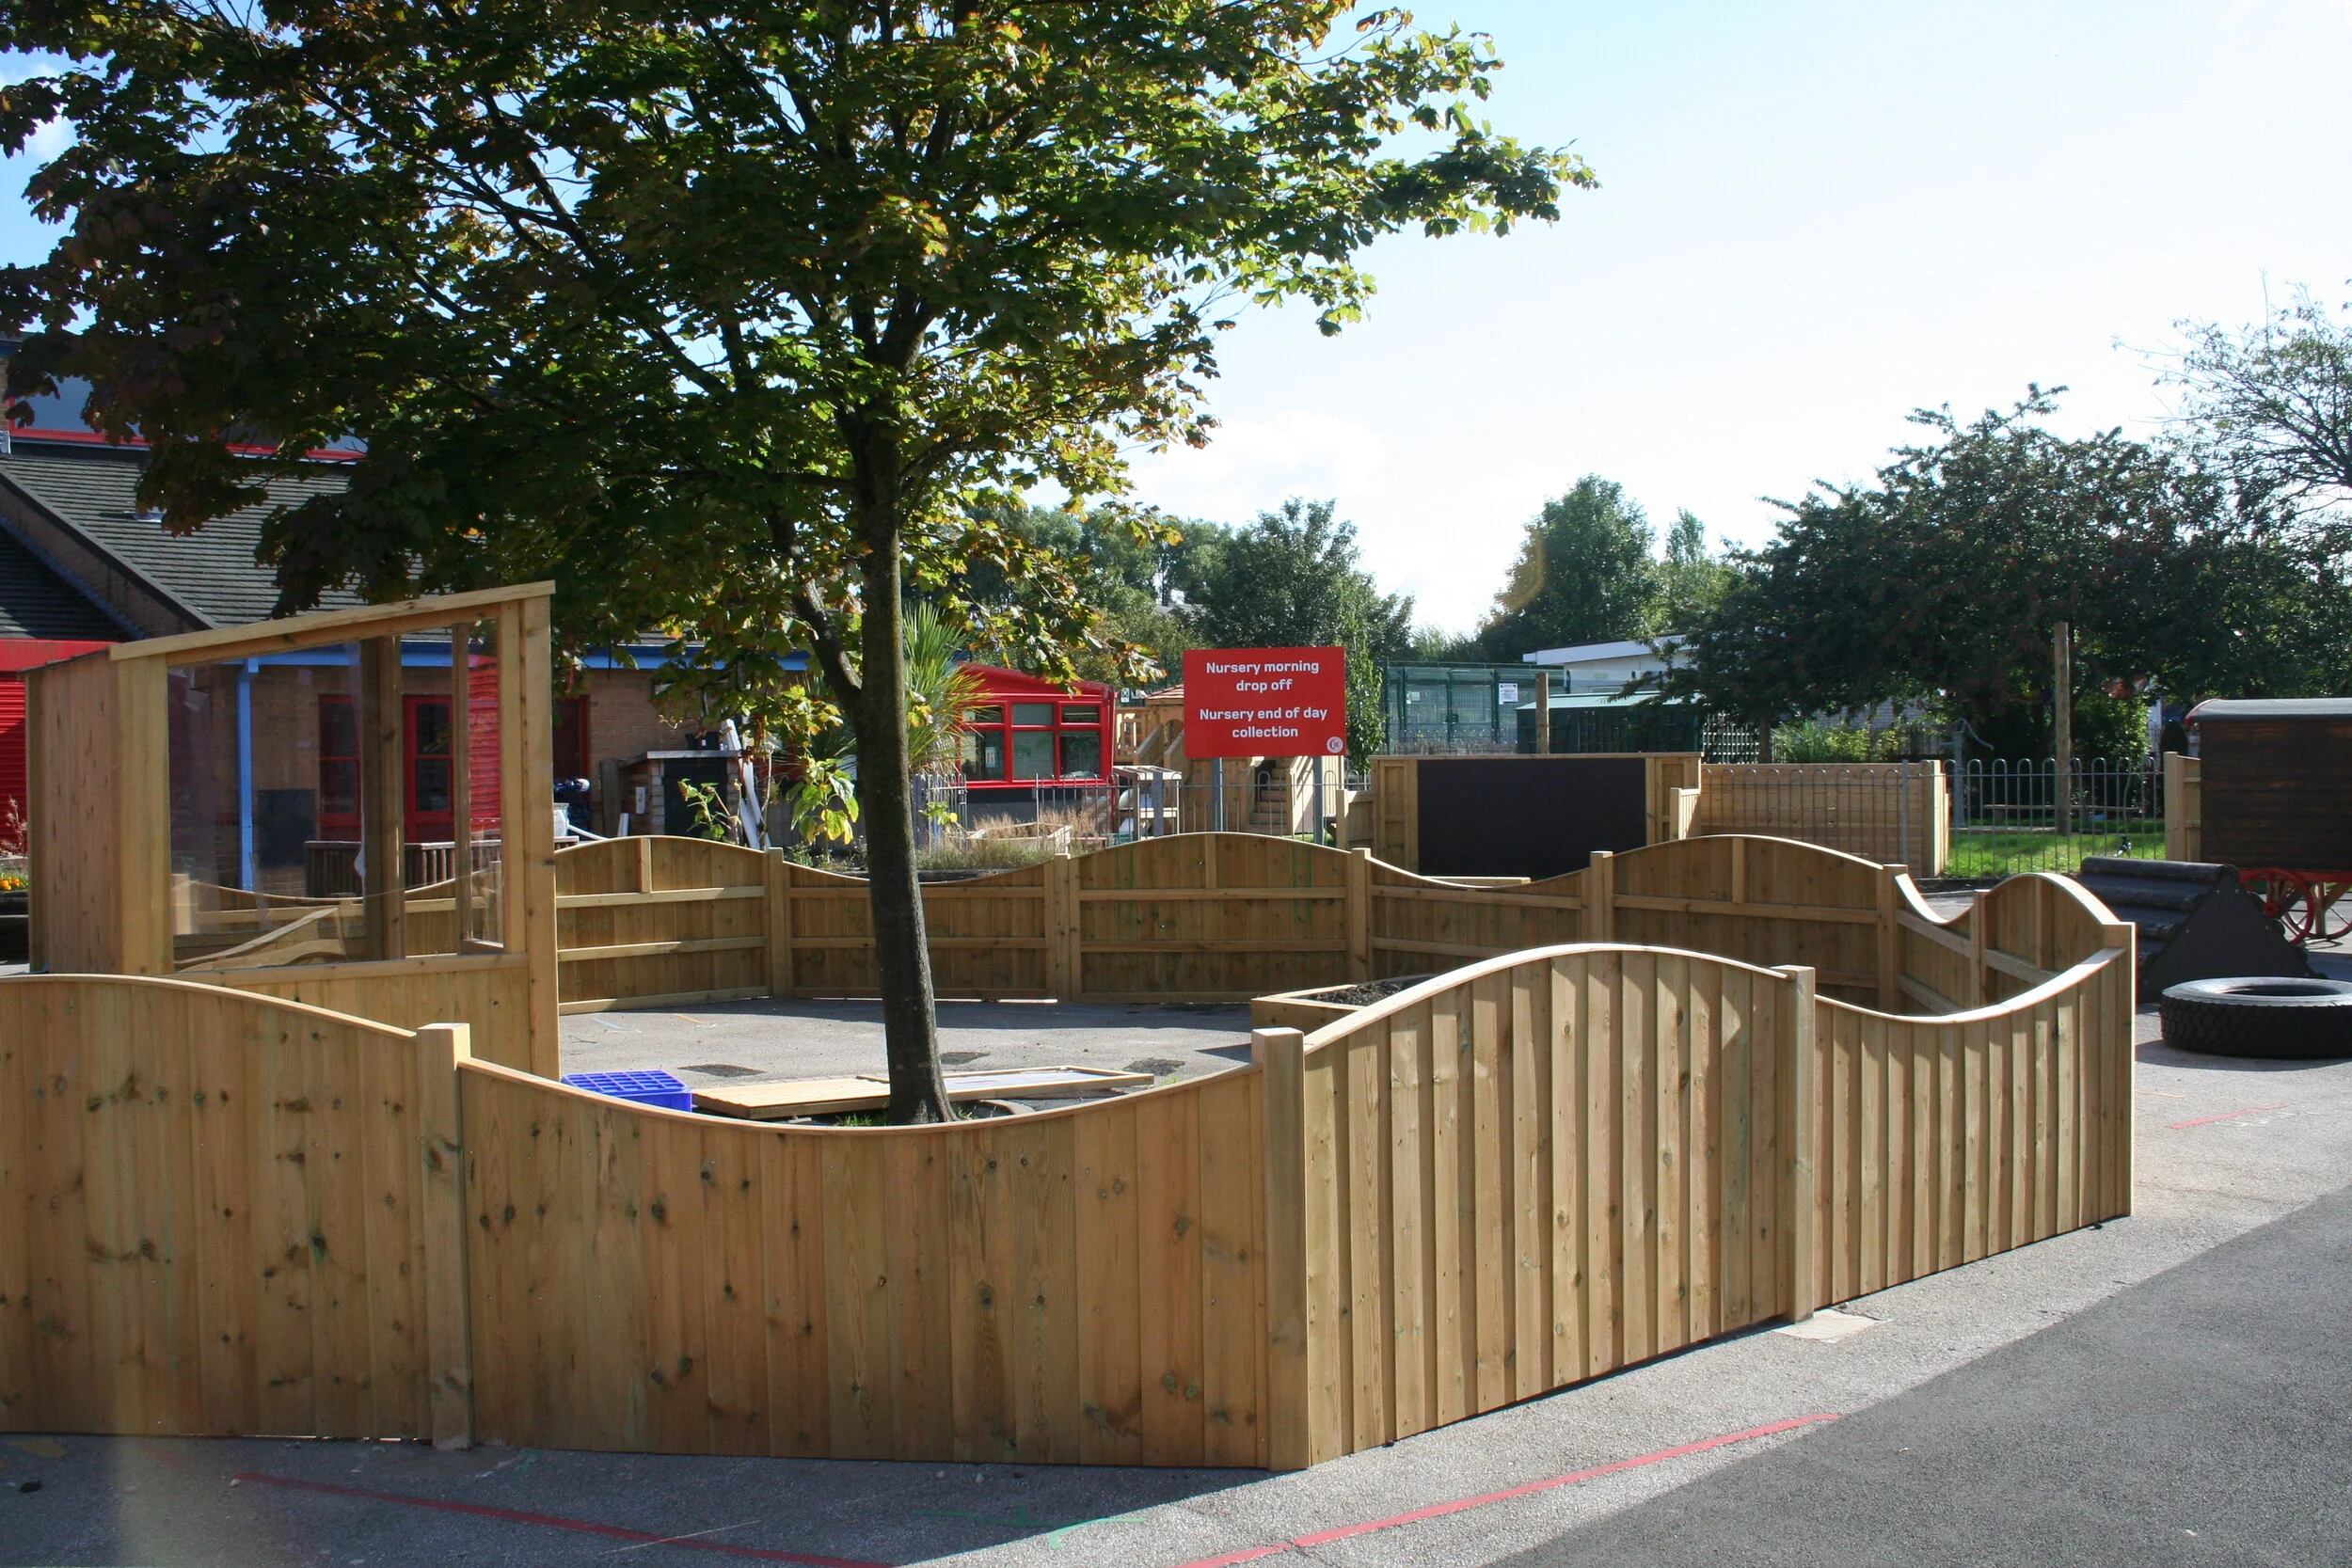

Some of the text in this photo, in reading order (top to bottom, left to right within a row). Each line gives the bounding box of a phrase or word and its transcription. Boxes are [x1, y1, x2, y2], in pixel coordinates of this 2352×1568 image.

[1206, 660, 1319, 675] Nursery morning
[1236, 678, 1293, 693] drop off
[1200, 706, 1327, 721] Nursery end of day
[1232, 726, 1298, 737] collection
